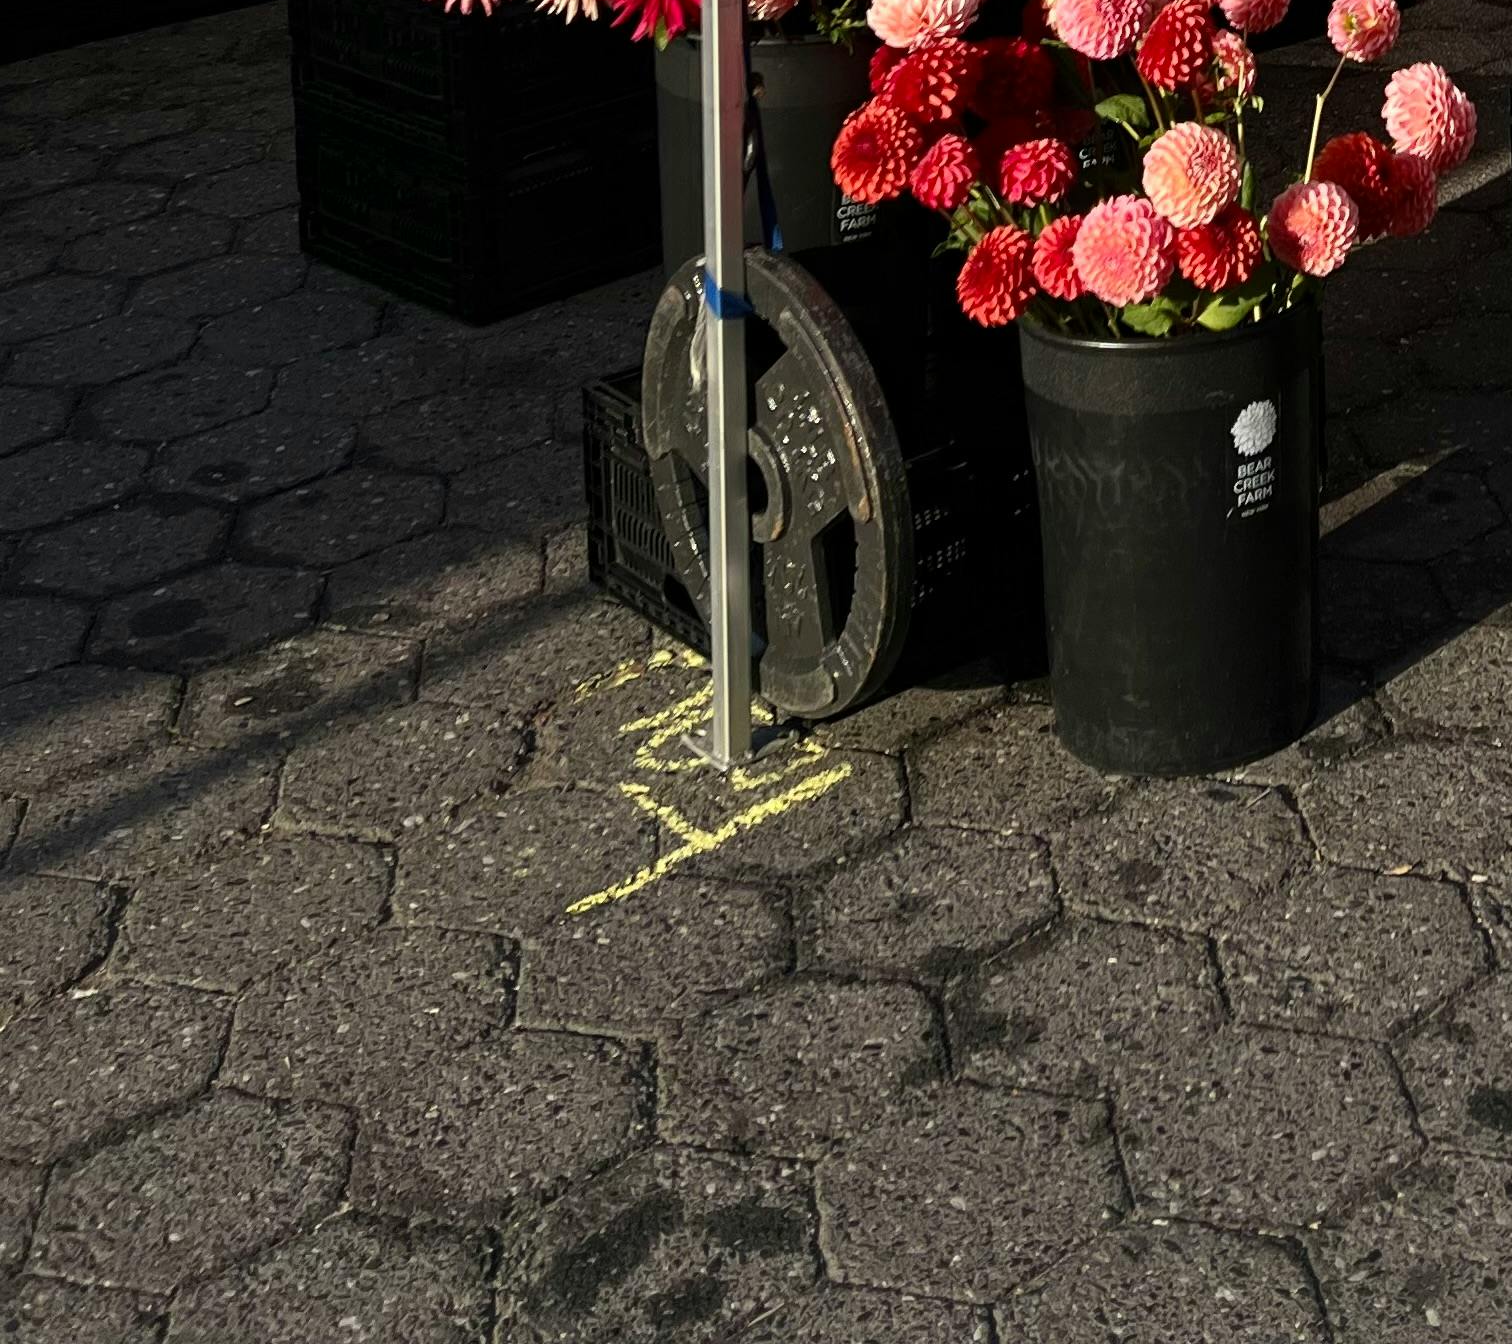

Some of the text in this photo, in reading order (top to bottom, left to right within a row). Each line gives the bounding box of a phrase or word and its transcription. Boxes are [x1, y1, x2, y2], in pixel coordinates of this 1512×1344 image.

[1237, 456, 1273, 479] BEAR
[1233, 468, 1276, 495] CREEK
[1237, 484, 1273, 508] FARM
